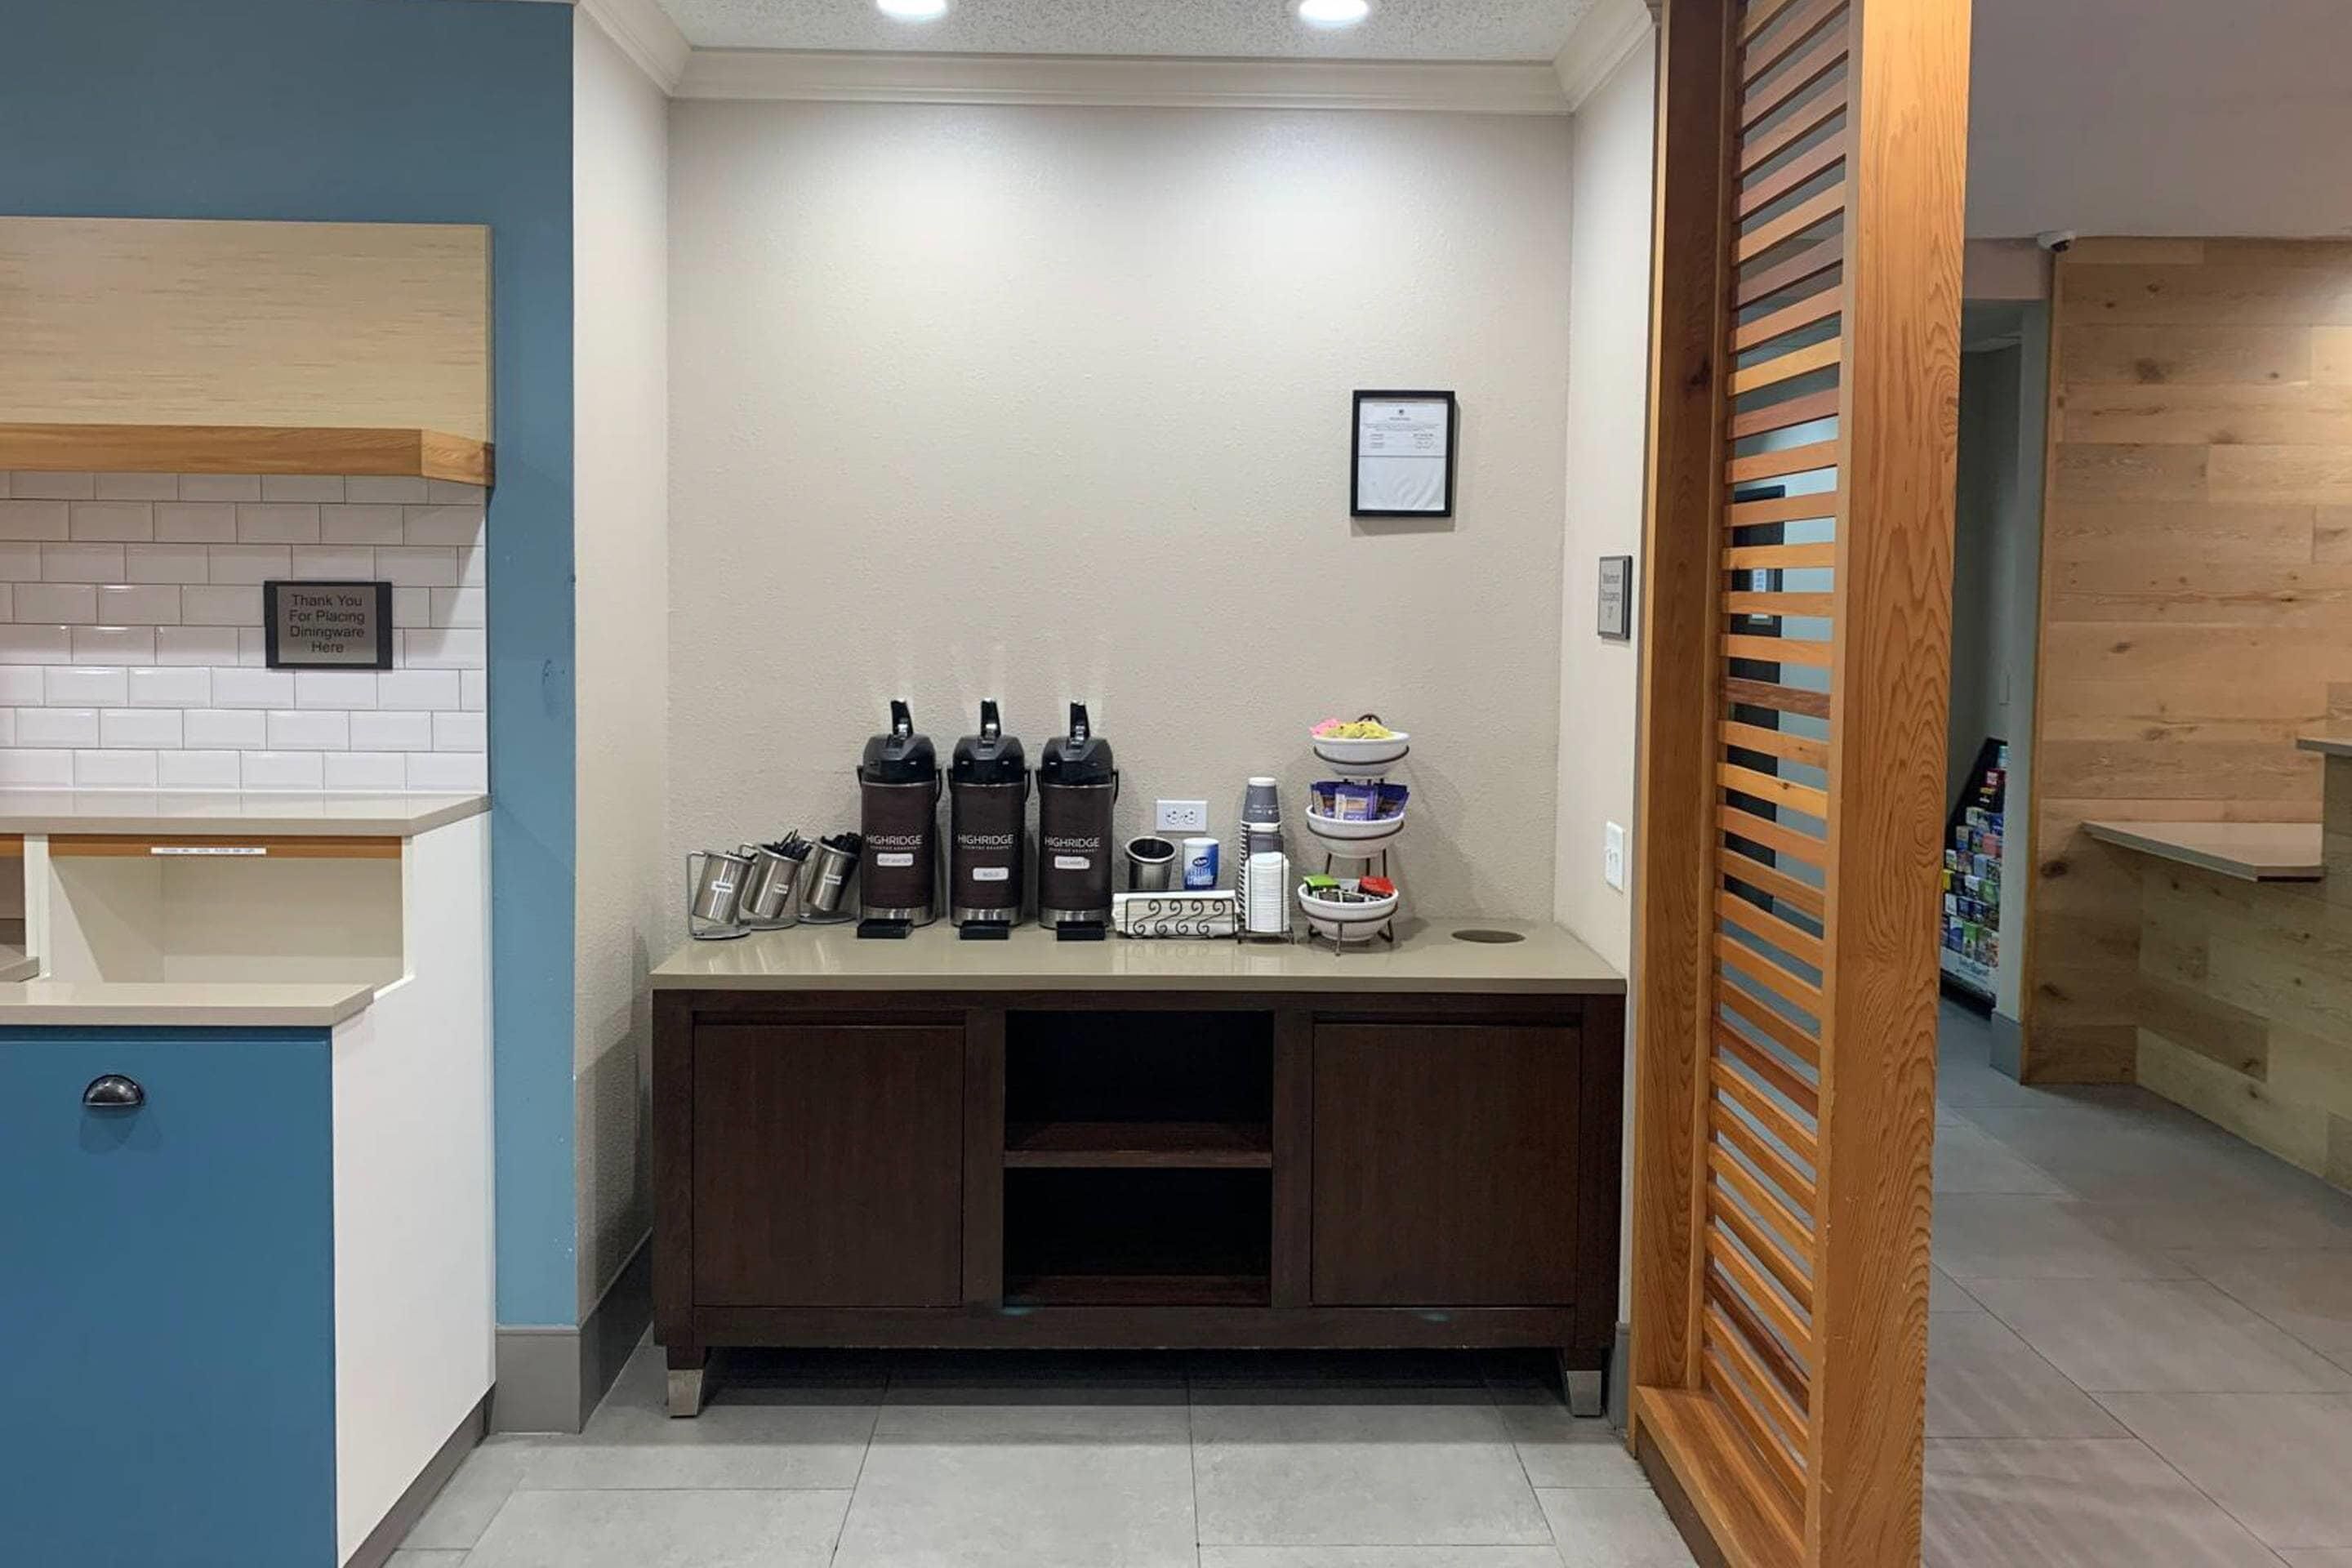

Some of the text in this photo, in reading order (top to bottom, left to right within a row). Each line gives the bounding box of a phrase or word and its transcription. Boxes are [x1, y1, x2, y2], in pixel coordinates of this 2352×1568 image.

[292, 594, 363, 607] Thank You
[289, 609, 365, 625] For Placing
[289, 626, 364, 639] Diningware
[311, 642, 345, 653] Here
[866, 834, 923, 845] HIGHRIDGE
[958, 834, 1014, 844] HIGHRIDGE
[1045, 836, 1100, 848] HIGHRIDGE
